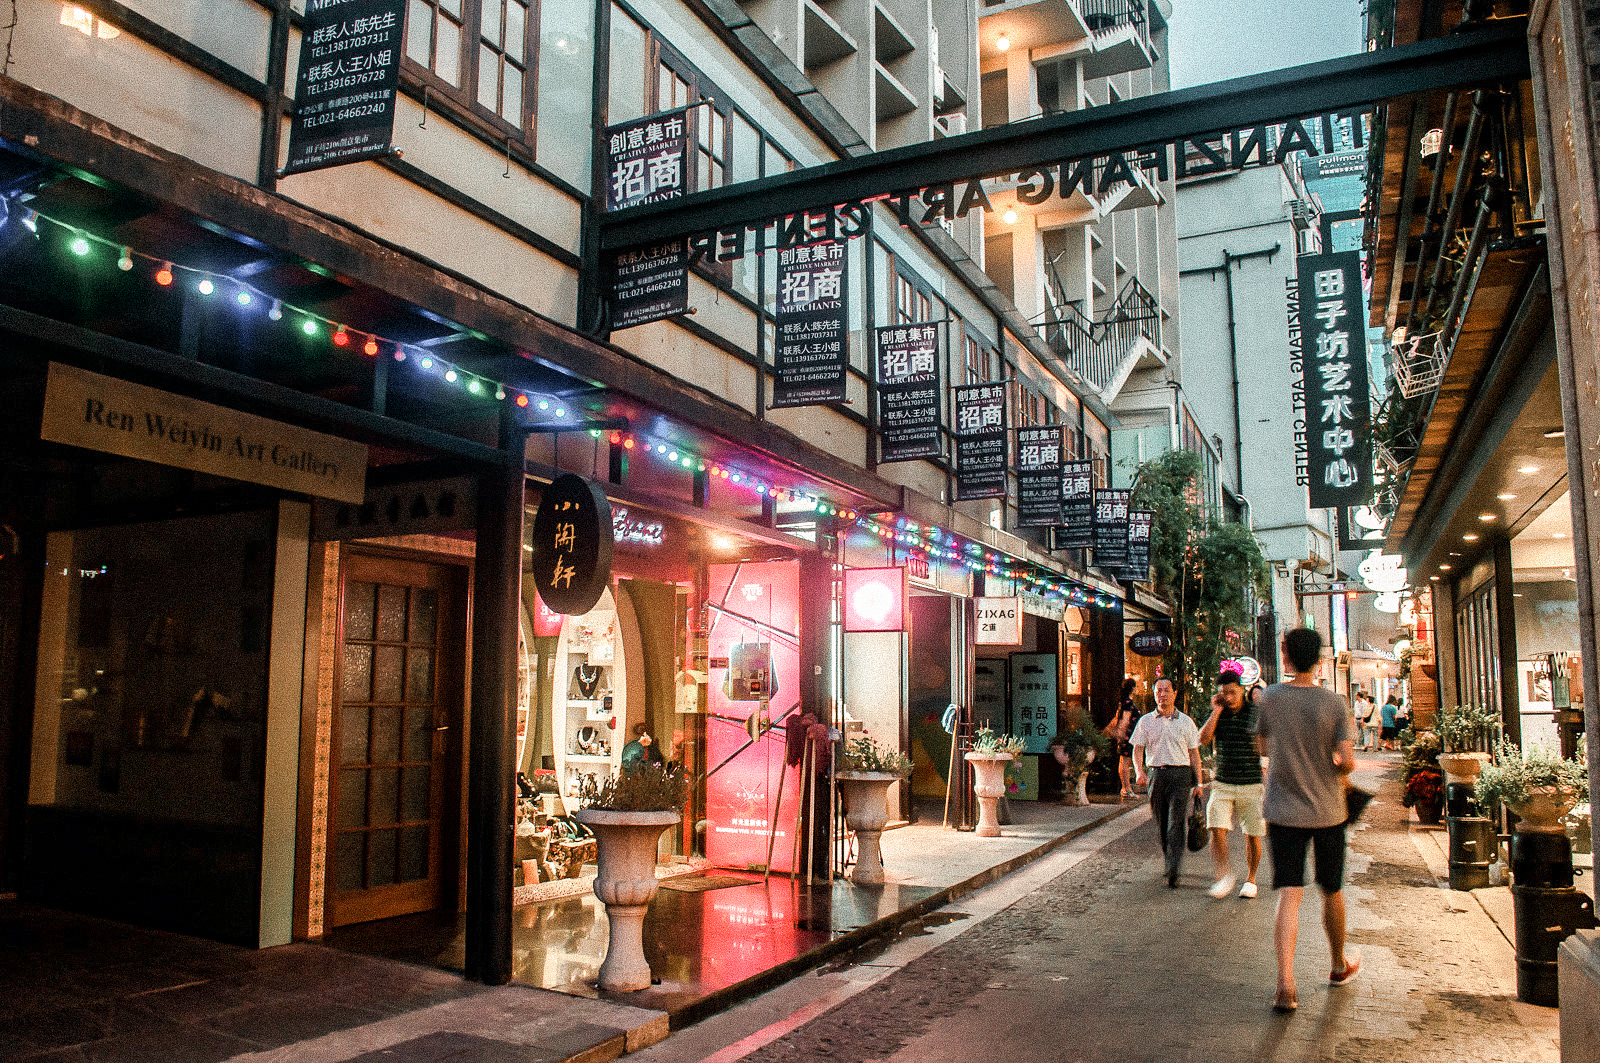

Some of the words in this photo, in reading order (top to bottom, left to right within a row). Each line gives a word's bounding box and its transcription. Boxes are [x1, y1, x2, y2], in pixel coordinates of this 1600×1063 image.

[313, 12, 396, 44] 联系人:陈先生
[311, 31, 389, 58] TEL:13817037311
[308, 49, 391, 82] 联系人:王小姐
[307, 70, 386, 95] TEL:13916376728
[303, 103, 386, 128] TEL:021-64662240
[610, 118, 683, 155] 創意集市
[1319, 154, 1364, 167] pullman
[612, 150, 682, 203] 招商
[780, 243, 844, 265] 創意集市
[781, 268, 842, 304] 招商
[781, 301, 842, 314] MERCHANTS
[881, 325, 936, 345] 創意集市
[883, 347, 936, 377] 招商
[884, 374, 936, 385] MERCHANTS
[1314, 268, 1358, 488] 田子坊艺术中心
[959, 403, 1002, 429] 招商
[83, 398, 134, 432] Ren
[145, 412, 222, 452] Weiyin
[228, 436, 265, 462] Art
[271, 444, 340, 485] Gallery
[1020, 444, 1059, 466] 招商
[1063, 463, 1091, 473] 意集市
[1097, 503, 1128, 519] 招商
[976, 609, 1015, 619] ZIXAG
[1021, 706, 1048, 720] 商品
